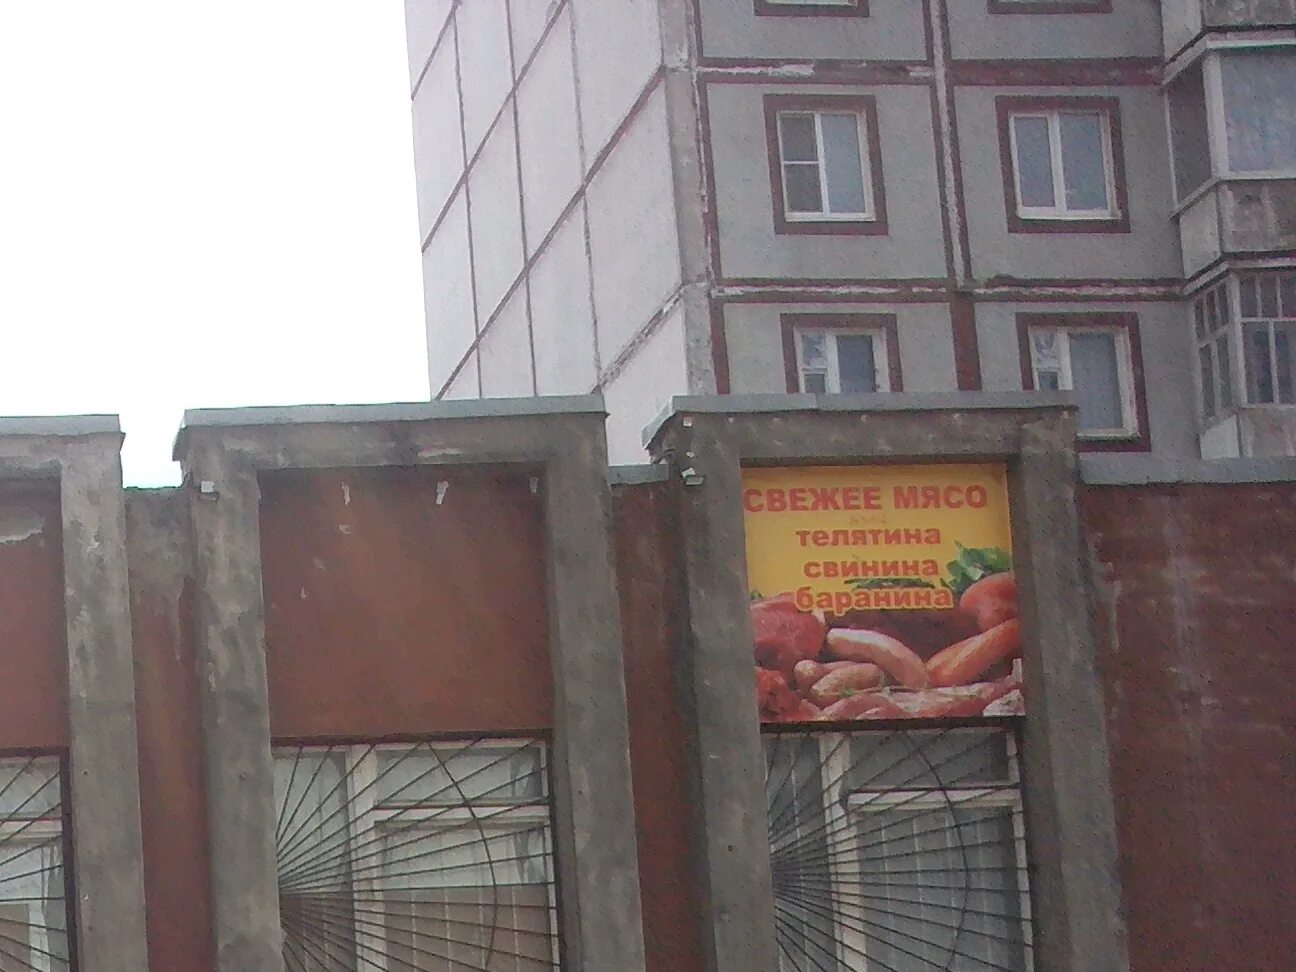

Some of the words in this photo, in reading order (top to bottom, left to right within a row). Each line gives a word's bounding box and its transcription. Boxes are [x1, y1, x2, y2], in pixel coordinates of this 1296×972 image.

[743, 486, 883, 513] СВЕЖЕЕ
[893, 484, 988, 509] МЯСО
[795, 527, 942, 547] телятина
[804, 558, 940, 579] свинина
[795, 587, 954, 616] баранина
